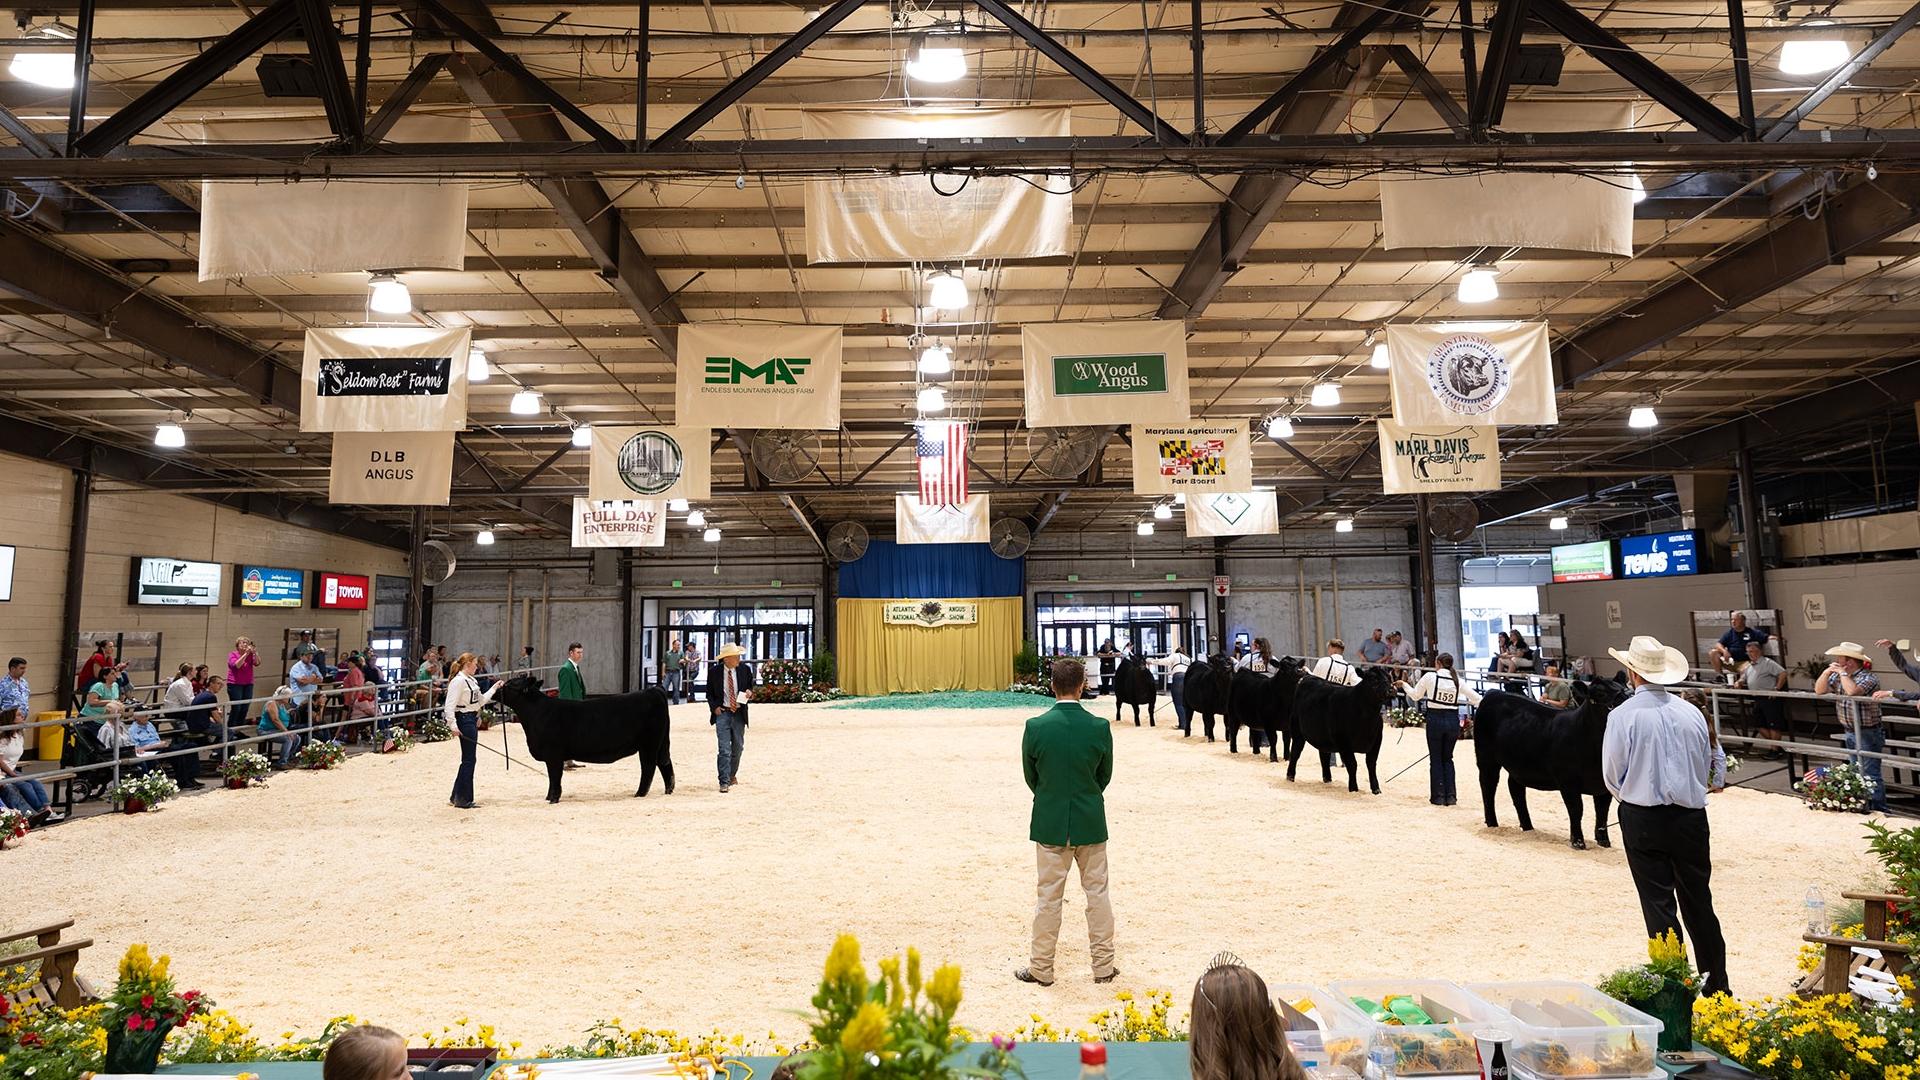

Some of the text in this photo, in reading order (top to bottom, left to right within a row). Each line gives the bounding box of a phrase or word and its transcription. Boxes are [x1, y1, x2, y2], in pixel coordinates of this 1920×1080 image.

[705, 357, 811, 384] EMAF
[1091, 362, 1138, 378] Wood
[408, 372, 444, 389] Farms
[1098, 374, 1149, 390] Angus
[1187, 427, 1238, 435] Agricultural
[1395, 439, 1470, 455] MARK DAVIS
[371, 451, 406, 462] DLB
[1427, 451, 1455, 464] Family
[365, 469, 414, 480] ANGUS
[583, 511, 657, 523] FULL DAY
[584, 523, 655, 535] ENTERPRISE
[338, 586, 364, 598] TOYOTA
[1438, 691, 1454, 703] 152
